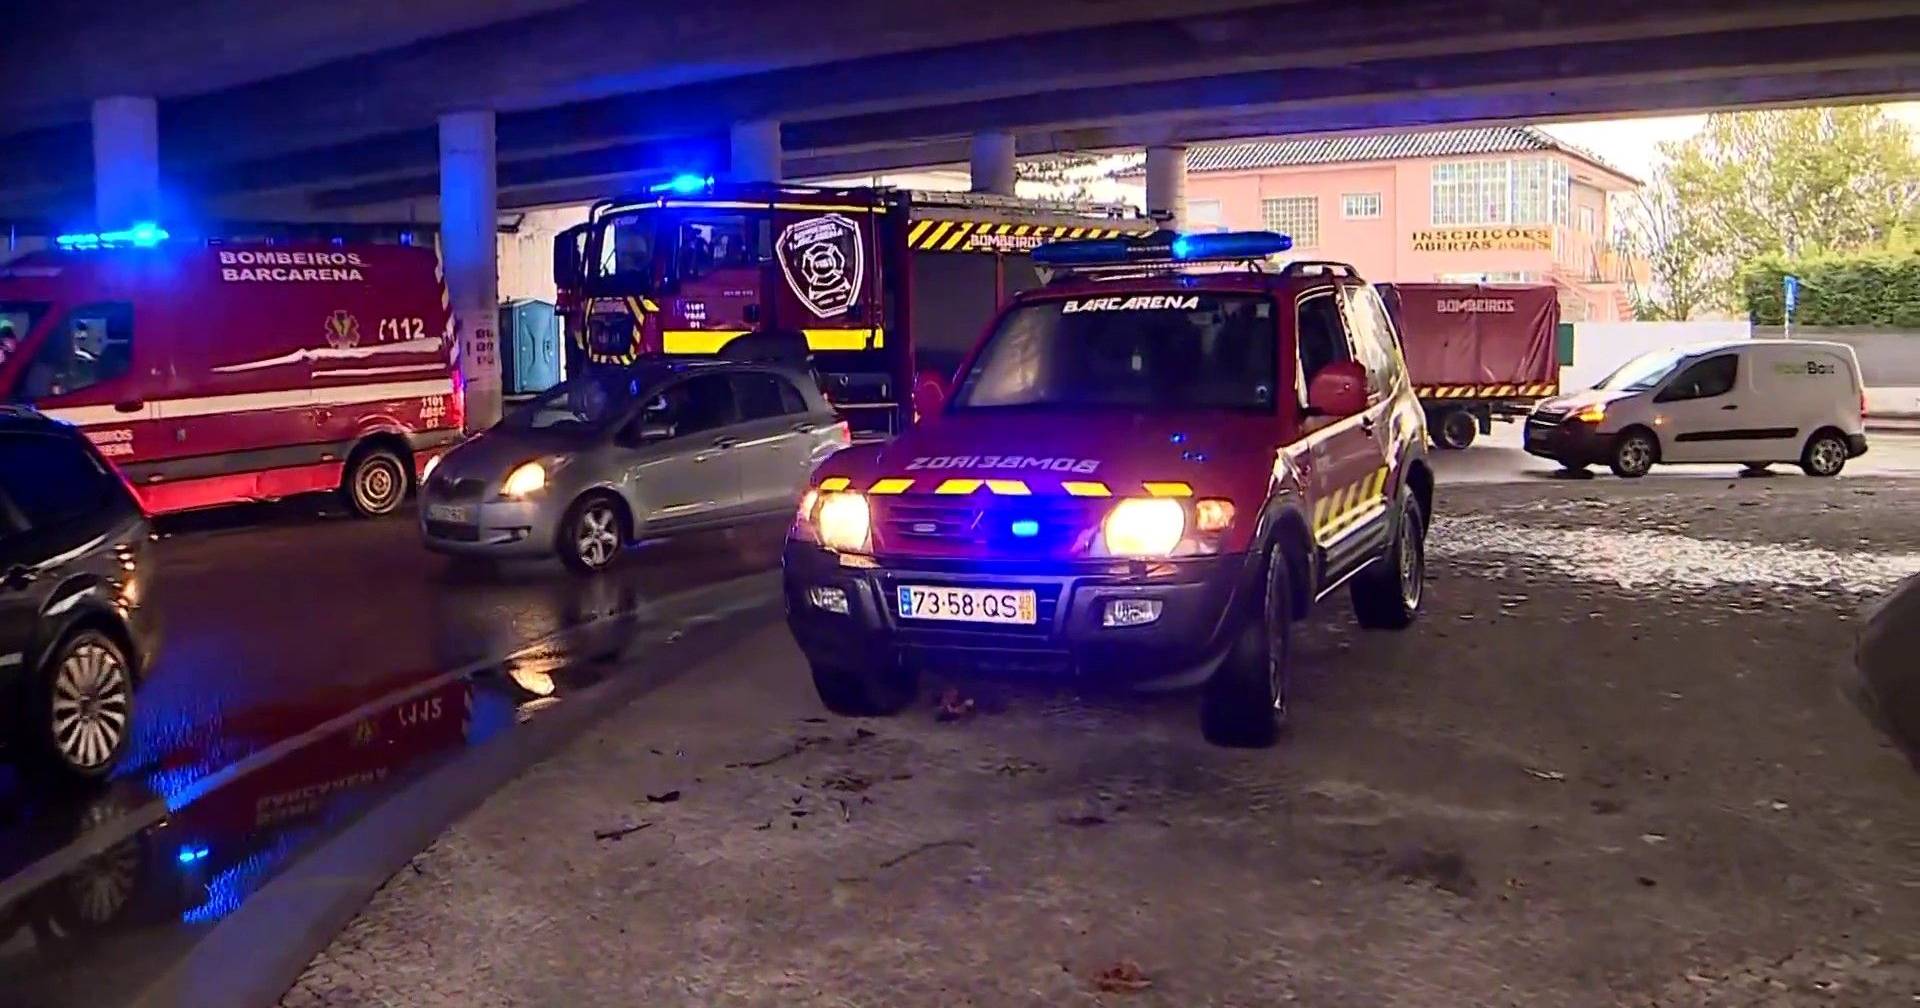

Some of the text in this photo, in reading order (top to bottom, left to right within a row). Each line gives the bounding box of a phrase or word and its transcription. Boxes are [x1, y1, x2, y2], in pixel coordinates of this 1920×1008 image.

[970, 234, 1042, 248] BOMBEIROS
[1414, 240, 1491, 251] ABERTAS
[219, 251, 363, 265] BOMBEIROS
[222, 268, 363, 281] BARCARENA
[1062, 296, 1199, 314] BARCARENA
[1437, 299, 1515, 312] BOMBEIROS
[388, 318, 425, 340] 112
